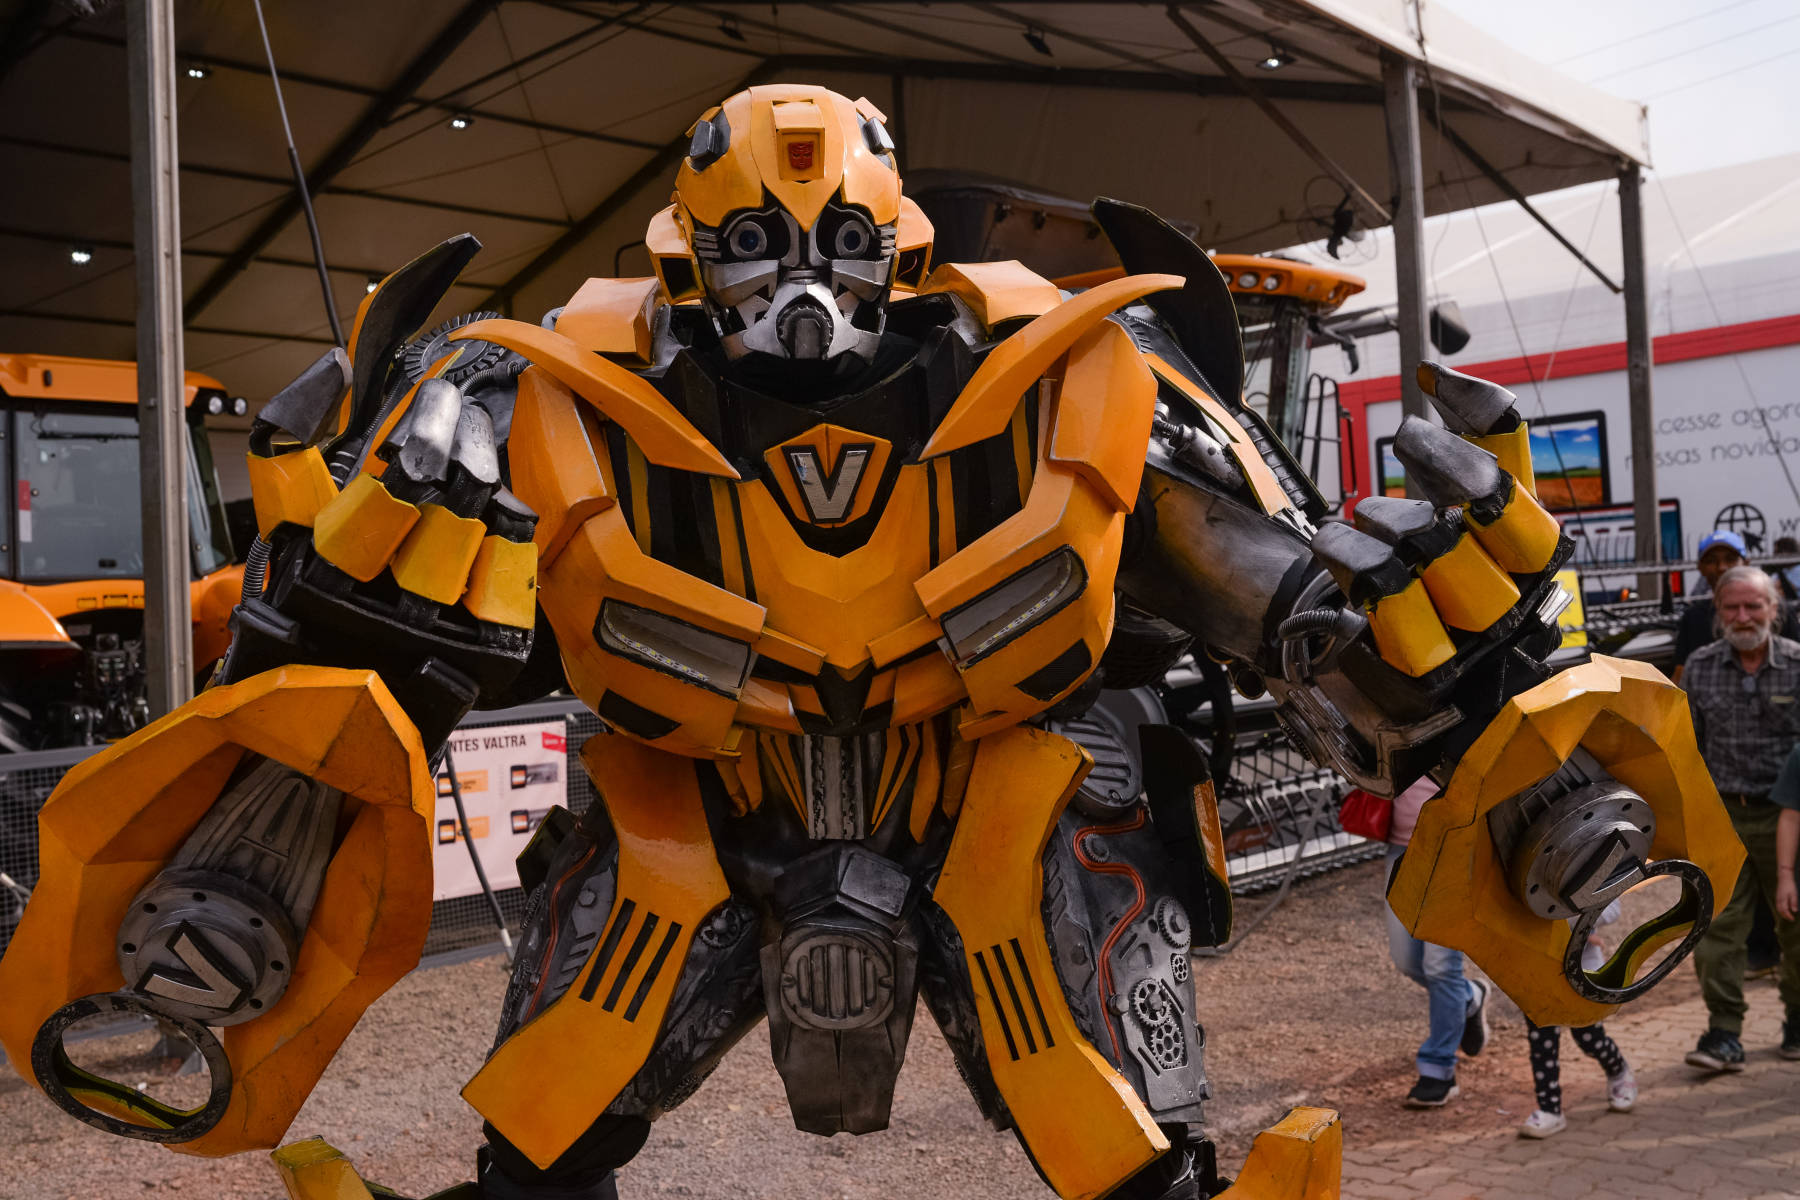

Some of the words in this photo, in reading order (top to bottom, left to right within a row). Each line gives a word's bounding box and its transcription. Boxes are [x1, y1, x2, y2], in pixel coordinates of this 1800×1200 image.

[1655, 411, 1721, 436] cesse
[1624, 447, 1702, 471] ssas
[784, 445, 871, 522] V
[449, 738, 479, 754] NTES
[483, 734, 527, 751] VALTRA
